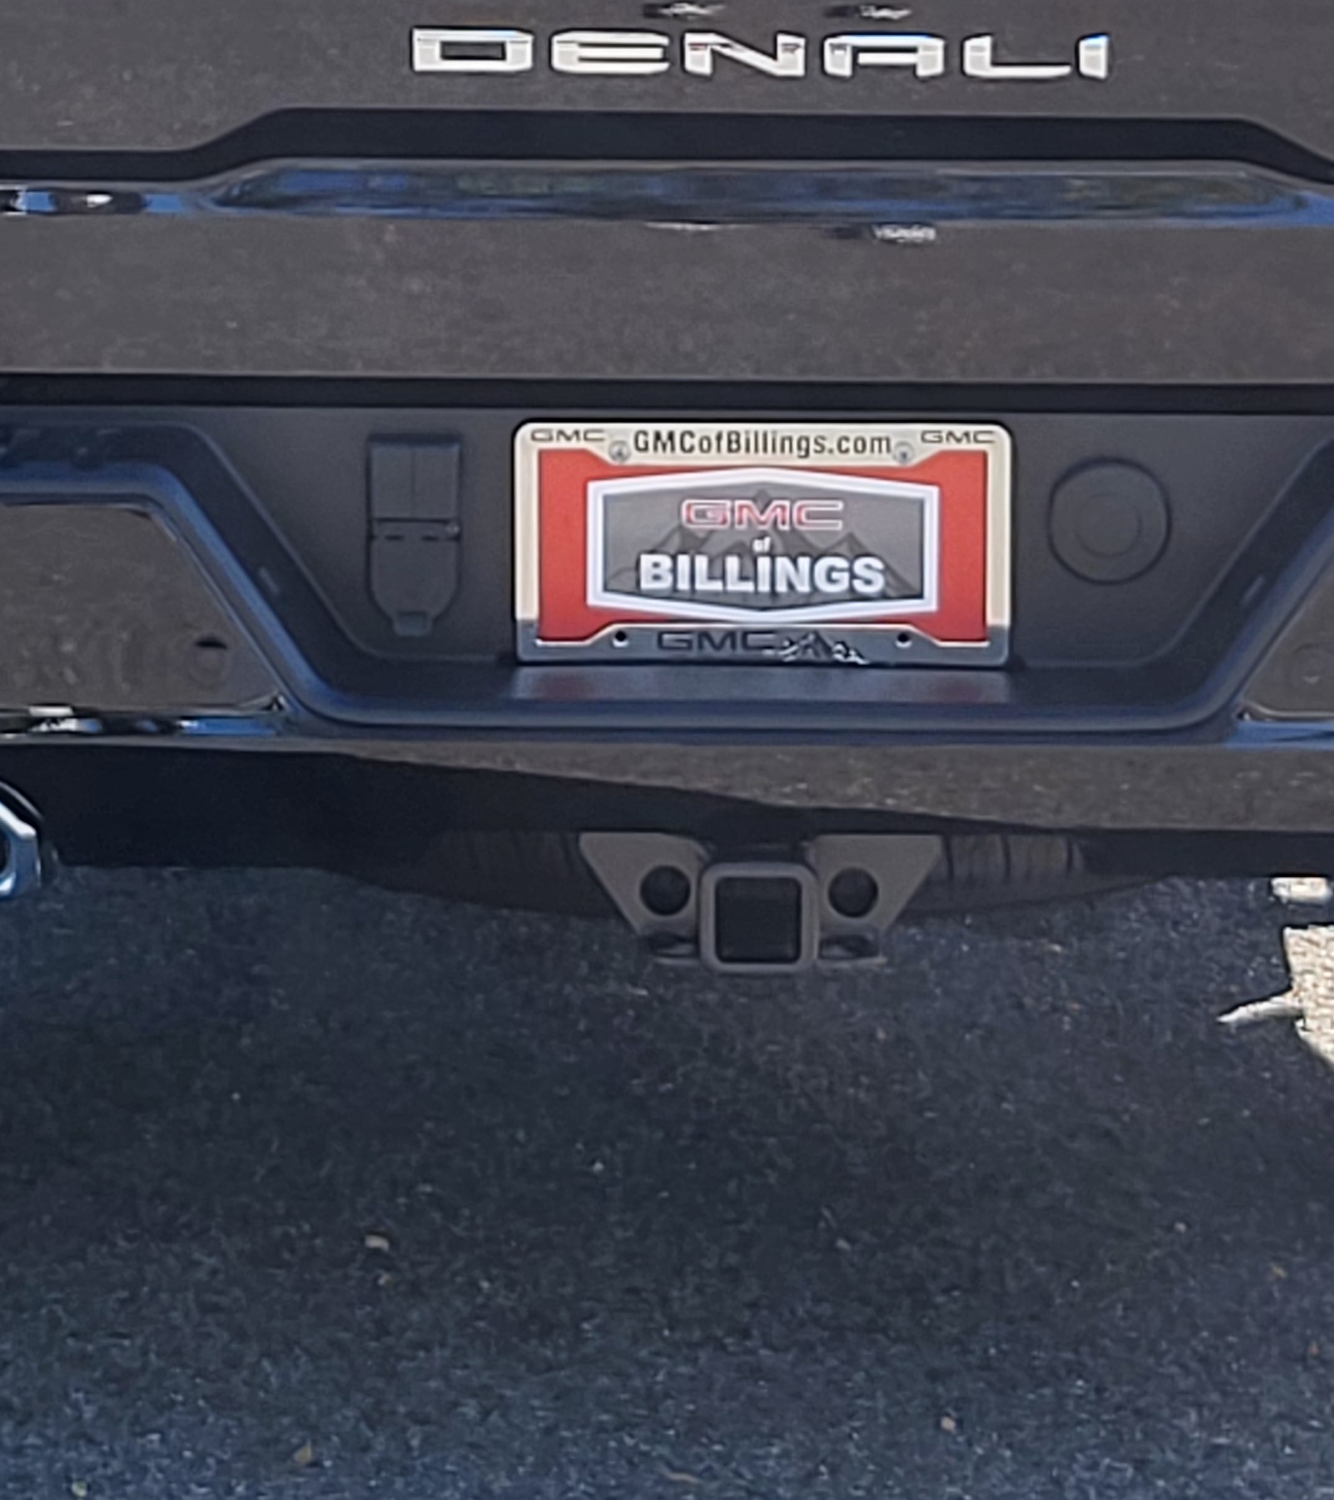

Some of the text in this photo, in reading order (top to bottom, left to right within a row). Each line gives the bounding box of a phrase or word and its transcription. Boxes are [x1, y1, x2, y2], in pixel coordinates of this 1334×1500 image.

[410, 27, 1110, 79] DENALI
[530, 429, 605, 443] GMC
[633, 430, 893, 459] GMCofBillings.com
[920, 430, 996, 445] GMC
[681, 499, 844, 531] GMC
[753, 536, 771, 553] of
[639, 553, 885, 593] BILLINGS
[656, 631, 778, 653] GMC
